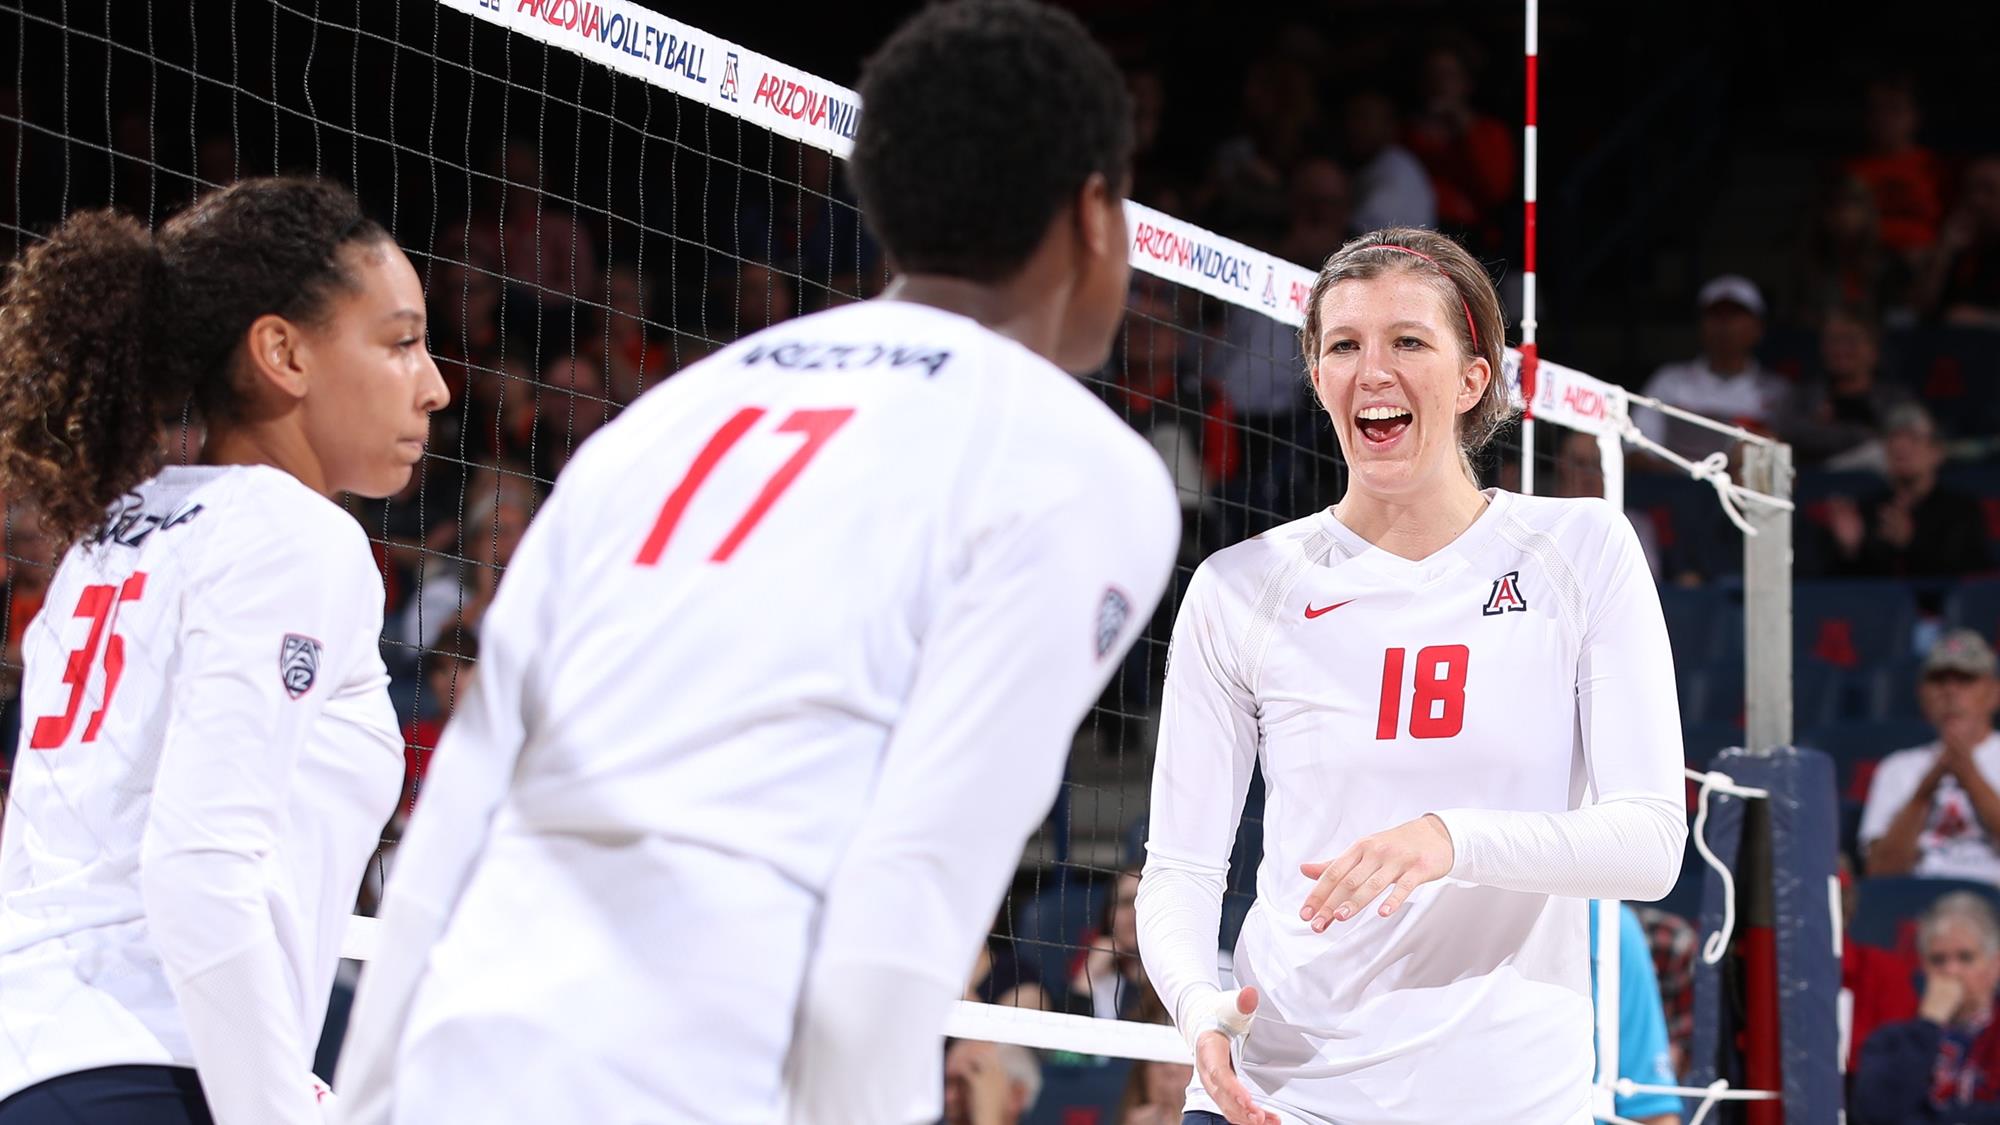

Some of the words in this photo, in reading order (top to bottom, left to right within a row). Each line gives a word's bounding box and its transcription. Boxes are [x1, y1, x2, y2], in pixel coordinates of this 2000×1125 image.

[633, 407, 858, 567] 17
[1483, 571, 1527, 616] A
[29, 571, 148, 749] 35
[1376, 644, 1470, 740] 18
